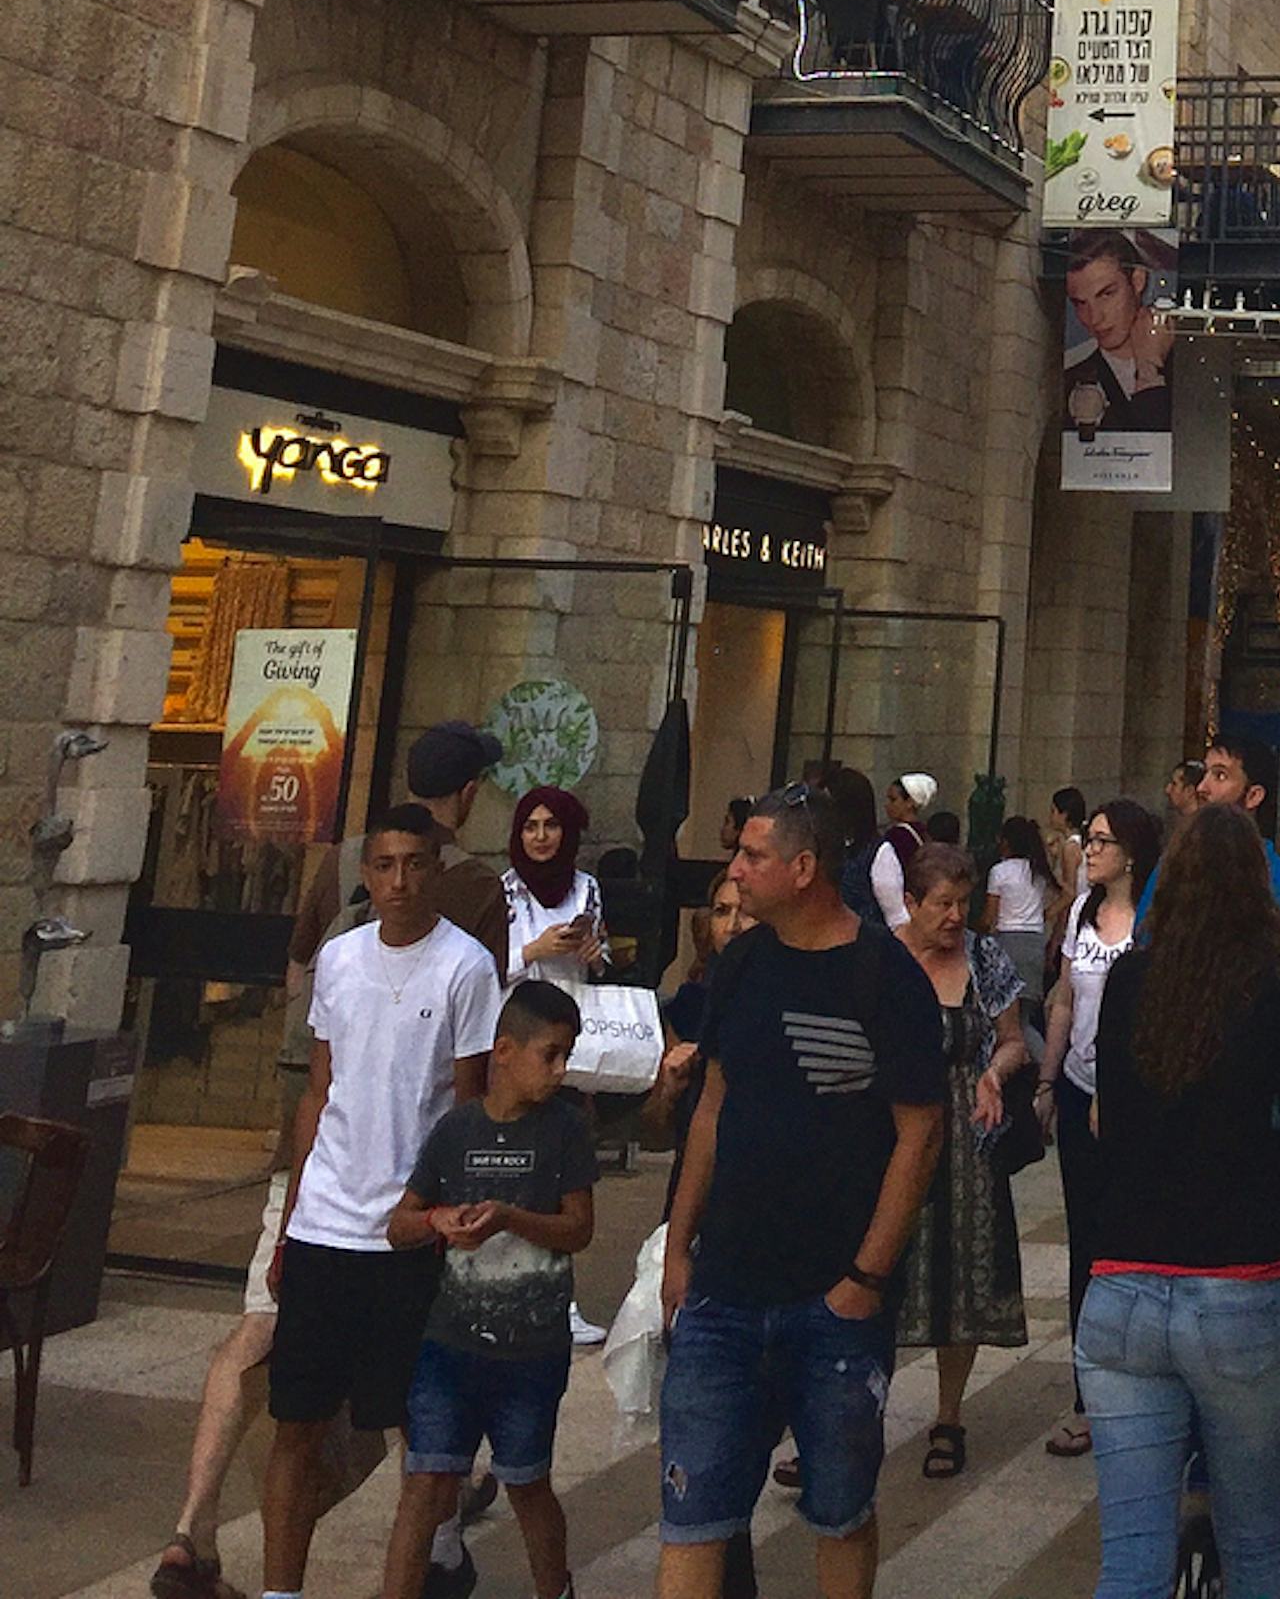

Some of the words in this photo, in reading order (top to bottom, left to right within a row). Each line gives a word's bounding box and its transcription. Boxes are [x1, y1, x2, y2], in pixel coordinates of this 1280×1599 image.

[1079, 10, 1109, 36] גרג
[1116, 9, 1152, 37] קפה
[1130, 63, 1150, 83] של
[1077, 192, 1141, 221] greg
[702, 523, 751, 558] ARLES
[760, 533, 770, 562] &
[780, 539, 826, 570] KEITH
[265, 640, 287, 653] The
[289, 640, 311, 659] gift
[312, 639, 326, 659] of
[263, 659, 321, 689] Giving
[270, 775, 300, 802] 50
[582, 1018, 655, 1041] OPSHOP
